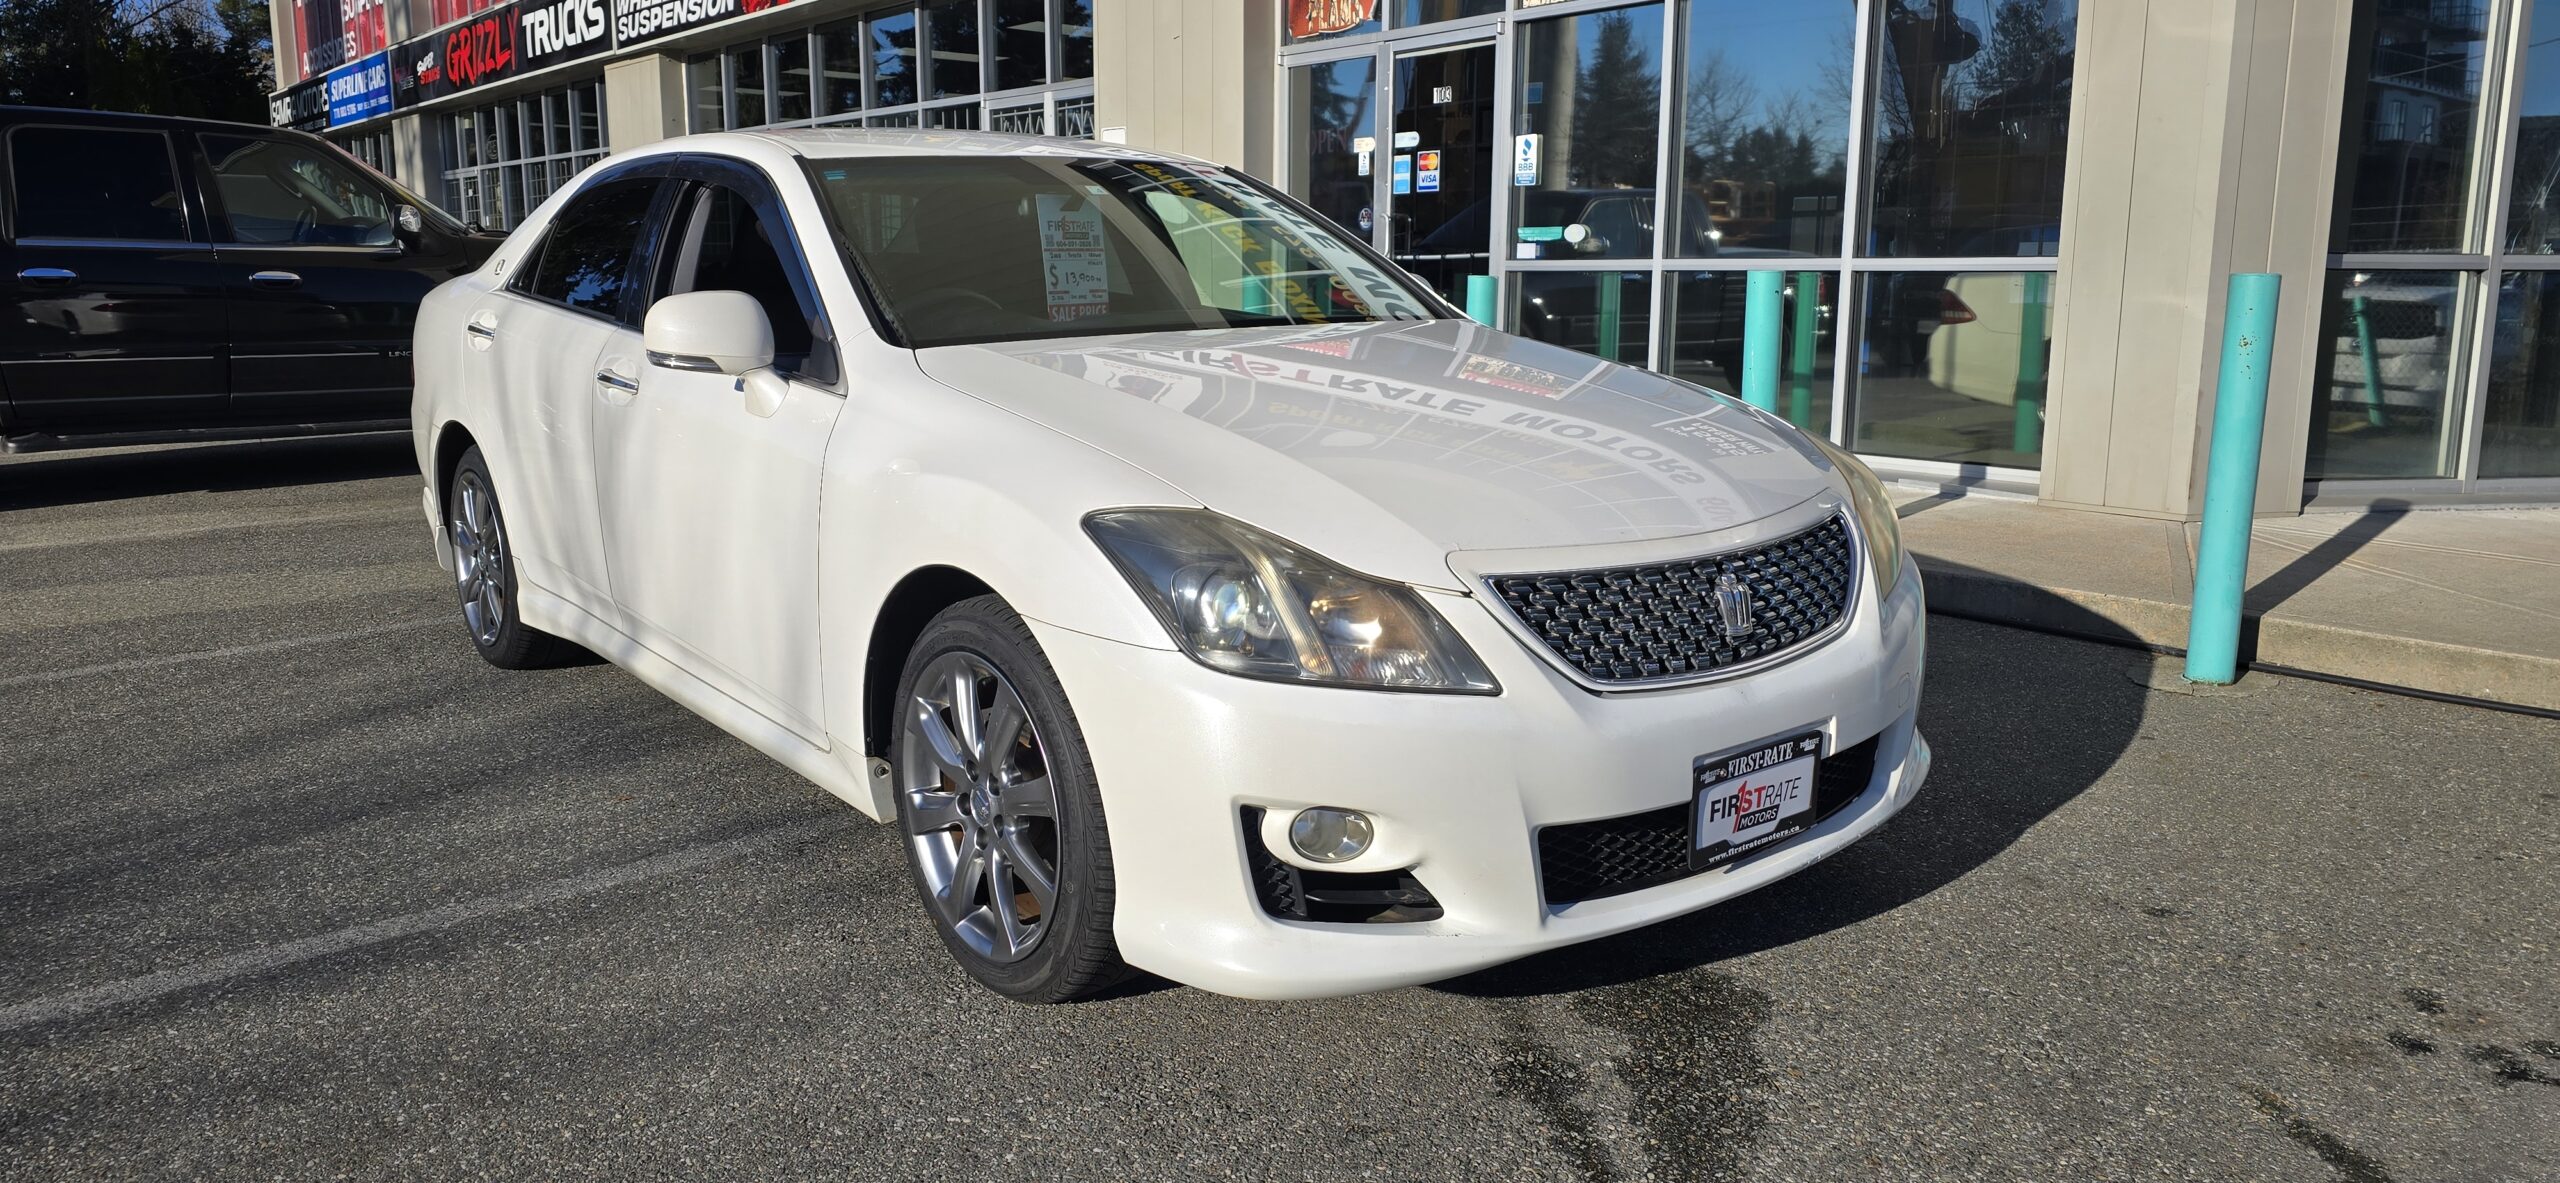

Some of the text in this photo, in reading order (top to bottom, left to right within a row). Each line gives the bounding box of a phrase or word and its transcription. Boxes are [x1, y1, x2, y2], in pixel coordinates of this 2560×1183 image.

[618, 0, 735, 41] SUSPENSION
[446, 0, 604, 88] GRIZZLY TRUCKS
[296, 82, 329, 120] MOTORS
[331, 69, 368, 102] SUPERLINE
[368, 63, 386, 91] CARS
[1421, 174, 1437, 183] VISA
[1052, 303, 1107, 322] SALE PRICE
[1727, 741, 1794, 779] FIRST-RATE
[1739, 807, 1778, 830] MOTORS
[1708, 825, 1801, 864] www.firstratemotors.ca
